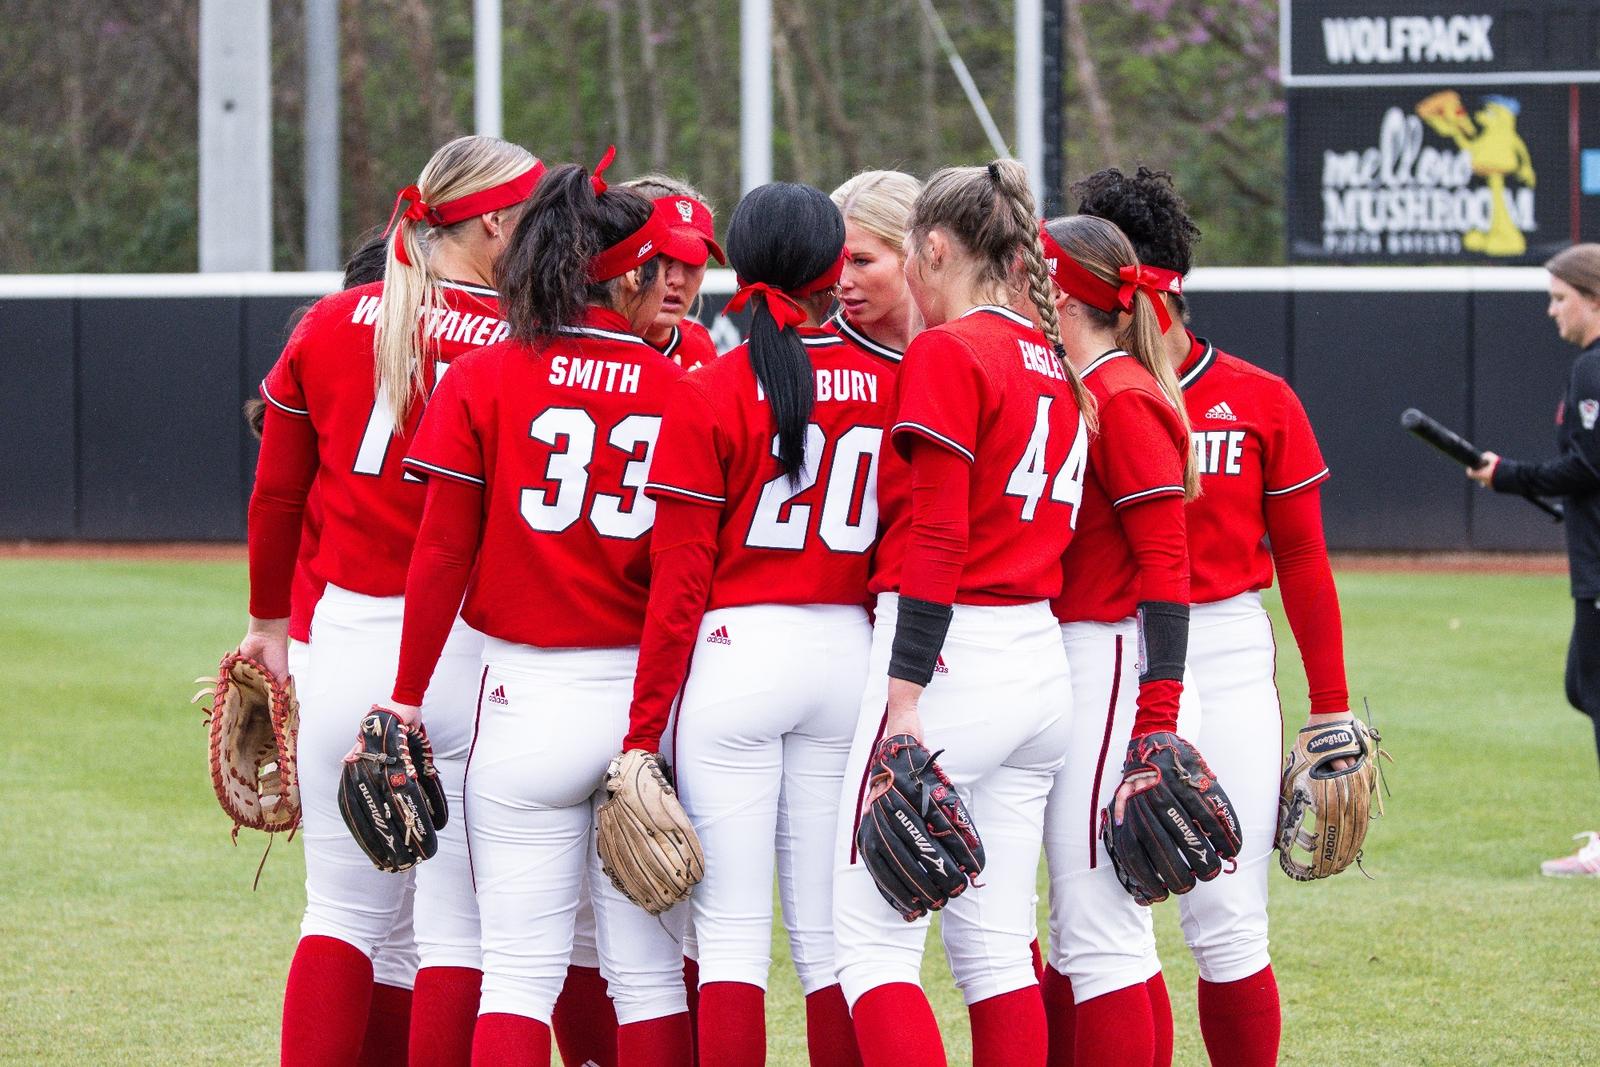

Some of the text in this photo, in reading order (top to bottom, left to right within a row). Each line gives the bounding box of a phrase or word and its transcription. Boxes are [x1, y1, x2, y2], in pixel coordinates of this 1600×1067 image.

[1322, 15, 1493, 63] WOLFPACK
[1322, 186, 1537, 232] MUSHROOM
[351, 295, 512, 347] WTAKER
[548, 355, 642, 394] SMITH
[1017, 338, 1067, 382] ENSLE
[757, 368, 877, 403] BURY
[1205, 411, 1237, 421] adidas
[520, 406, 663, 540] 33
[1004, 395, 1089, 530] 44
[1190, 430, 1248, 476] ATE
[743, 422, 884, 554] 20
[706, 636, 731, 646] adidas
[1310, 731, 1350, 750] Wilson
[358, 782, 389, 830] MIZUNO
[1166, 807, 1202, 846] MIZUNO
[894, 809, 937, 853] MIZUNO
[1324, 825, 1337, 861] A2000
